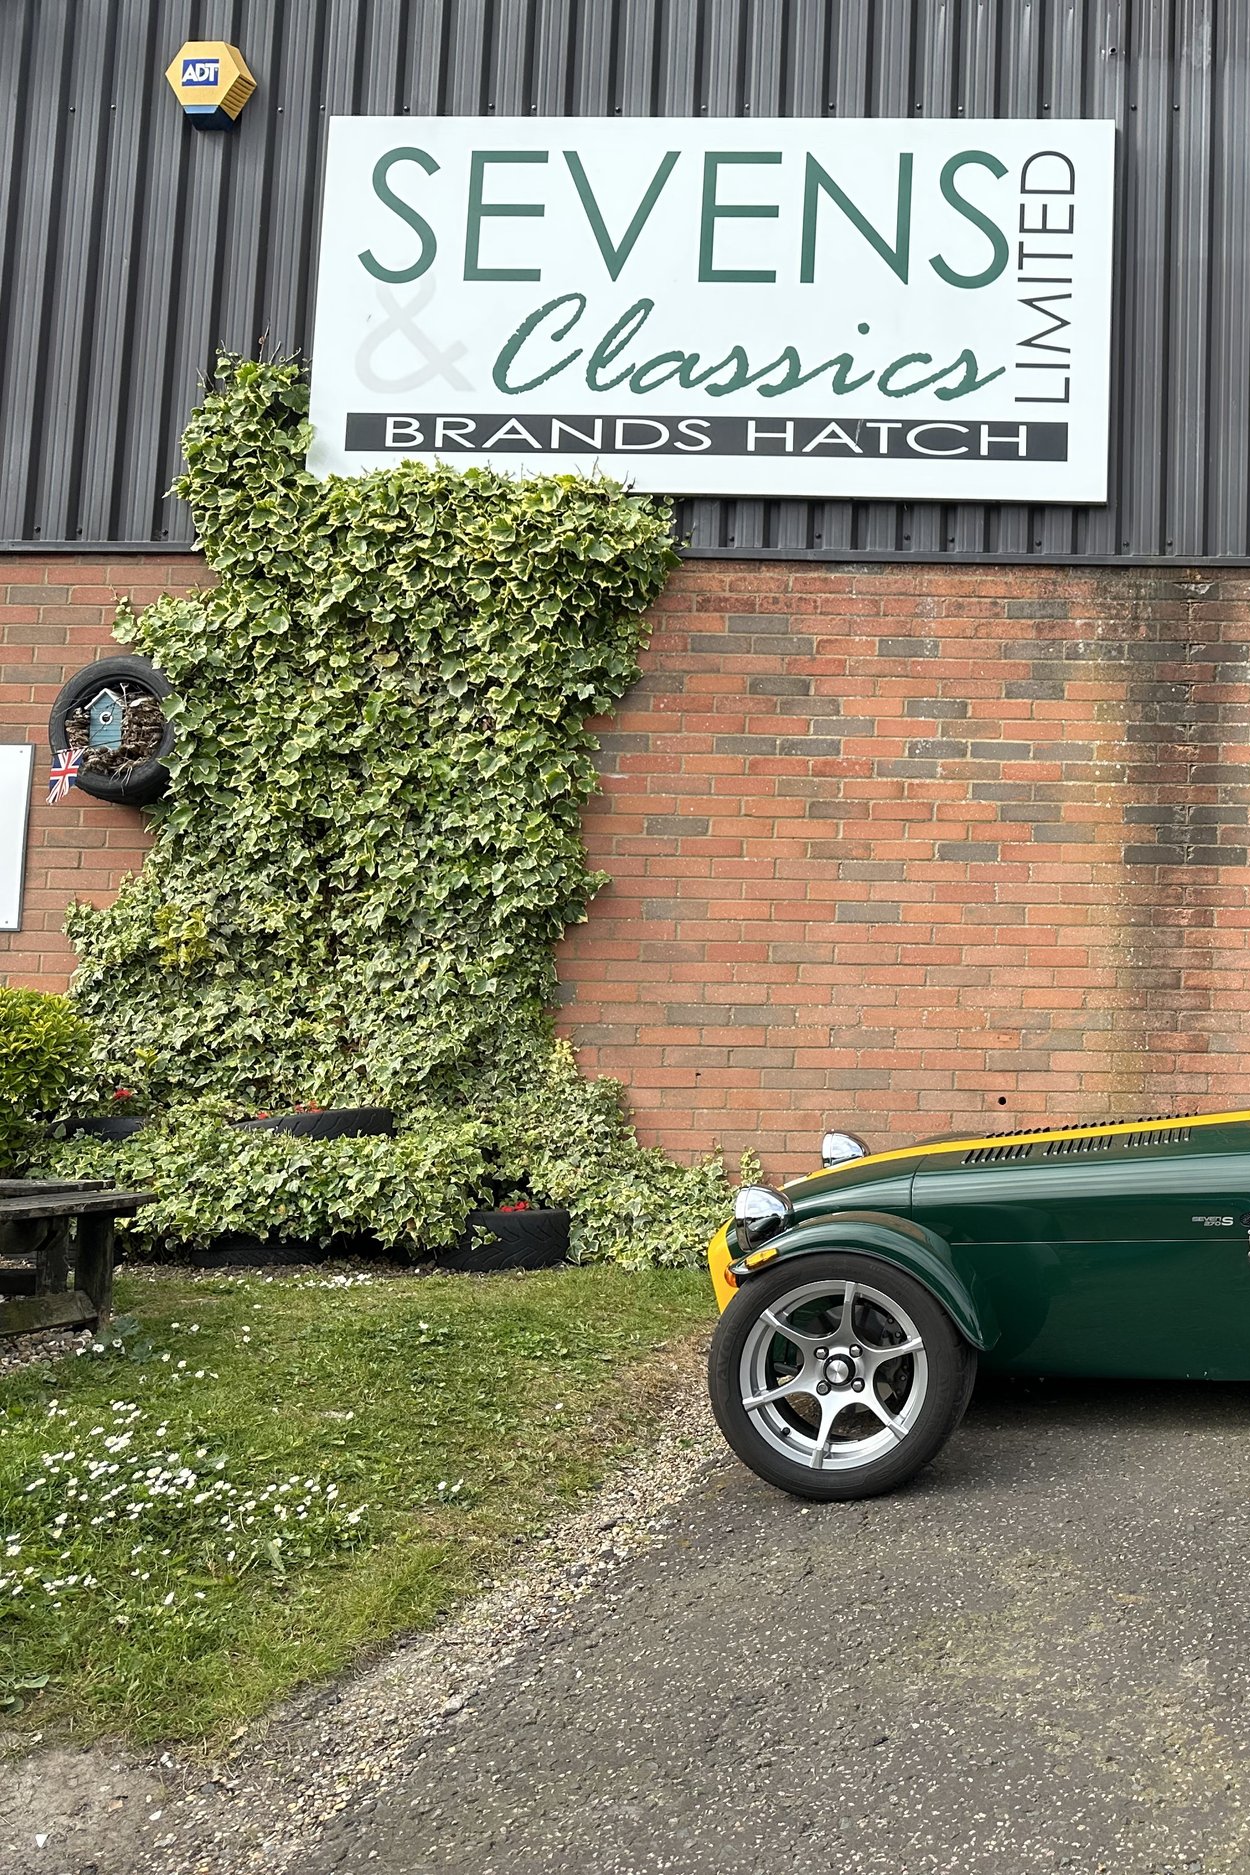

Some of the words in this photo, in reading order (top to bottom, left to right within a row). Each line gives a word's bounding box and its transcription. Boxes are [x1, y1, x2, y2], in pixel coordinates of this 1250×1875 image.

[181, 63, 219, 82] ADT
[358, 147, 1009, 289] SEVENS
[1014, 150, 1076, 404] LIMITED
[355, 271, 477, 394] &
[492, 292, 1006, 399] Classics
[385, 416, 713, 451] BRANDS
[745, 419, 1028, 458] HATCH
